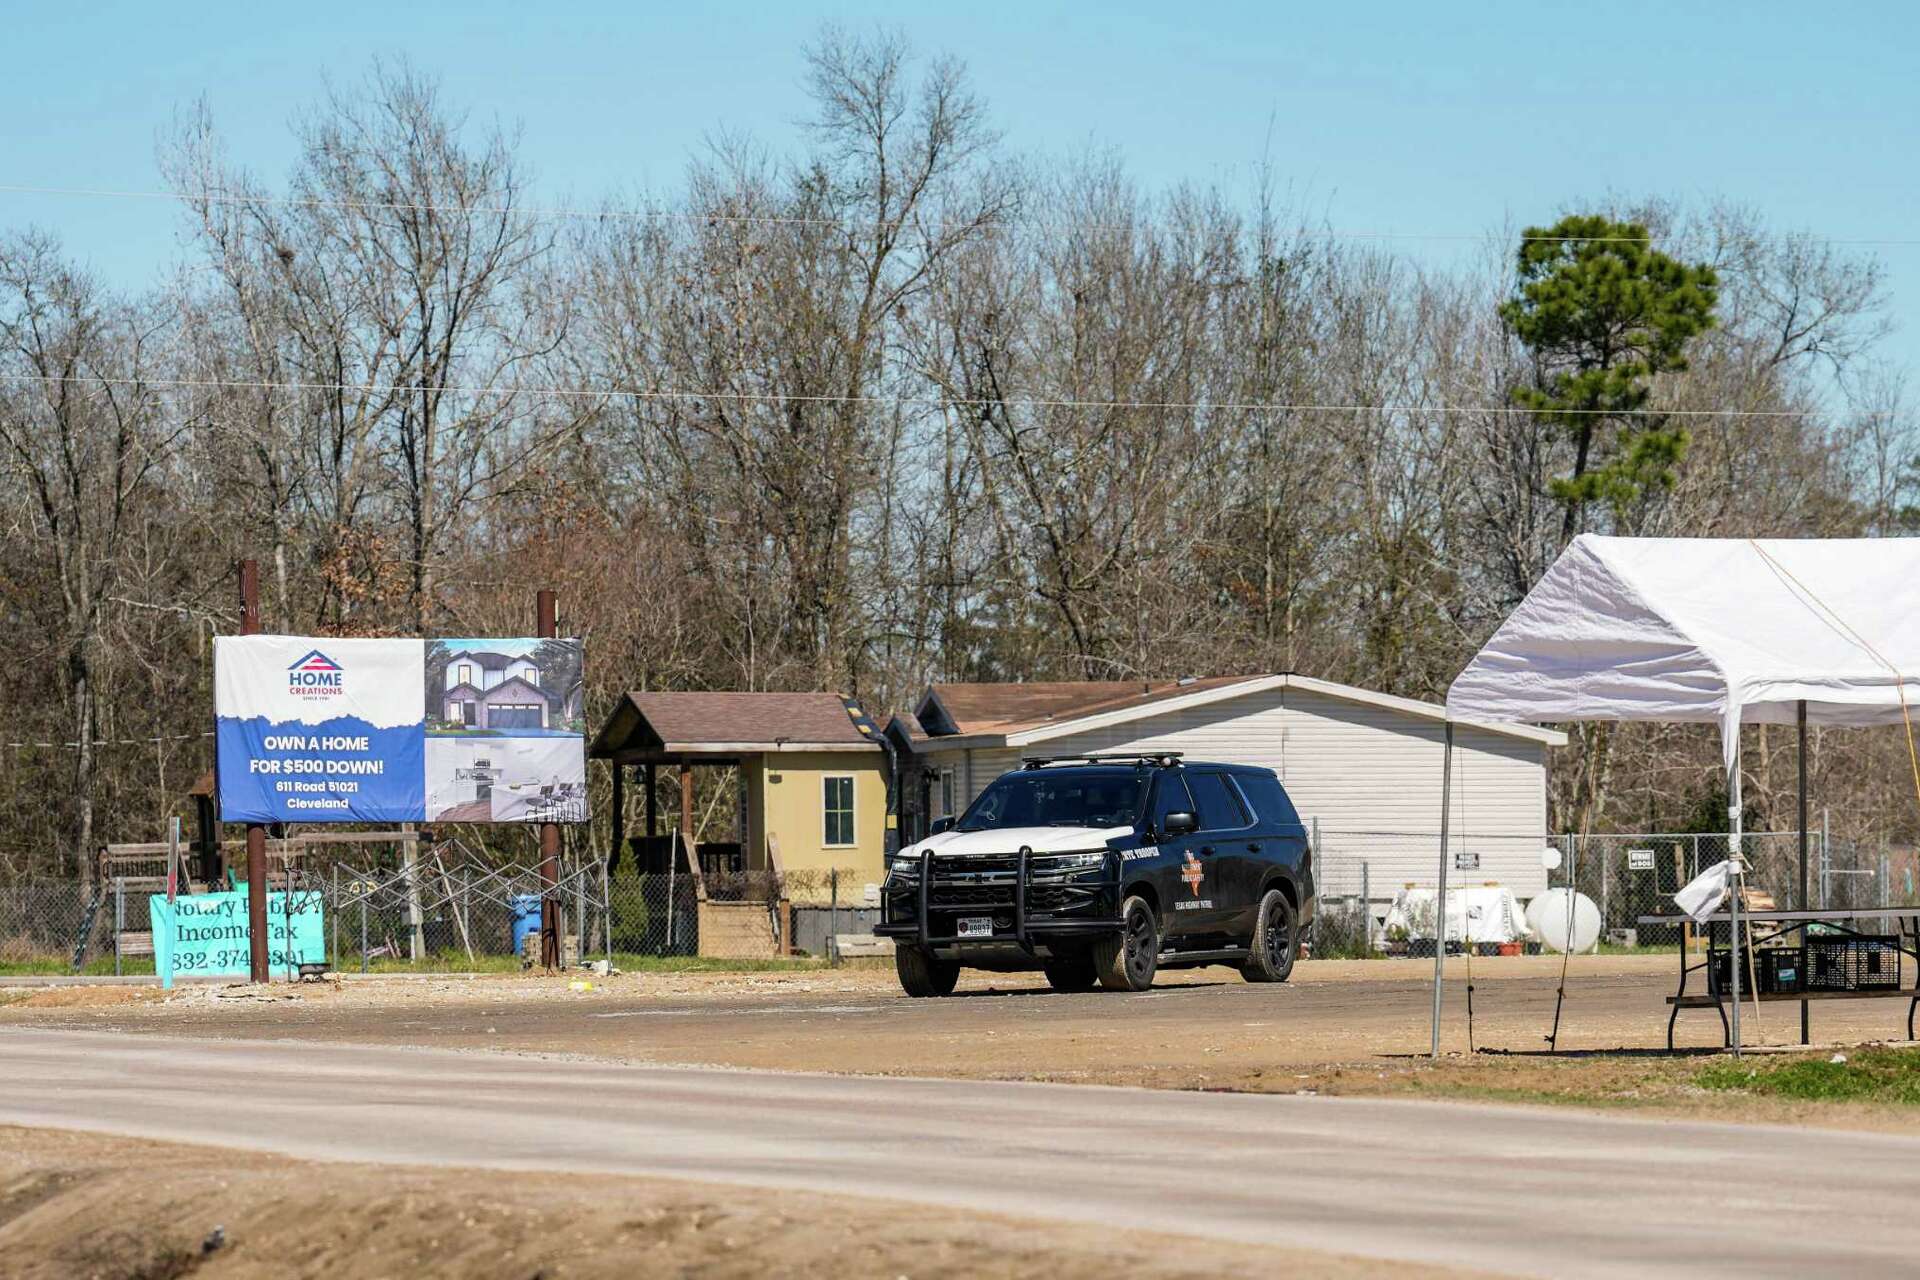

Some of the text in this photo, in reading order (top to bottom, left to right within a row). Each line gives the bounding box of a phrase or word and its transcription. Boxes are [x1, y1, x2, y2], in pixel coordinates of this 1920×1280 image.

[289, 672, 342, 686] HOME
[289, 687, 343, 695] CREATIONS
[263, 736, 369, 750] OWN A HOME
[250, 759, 384, 774] FOR $500 DOWN!
[276, 782, 358, 792] 611 Road 51021
[287, 798, 349, 809] Cleveland
[172, 949, 304, 971] 832-374391
